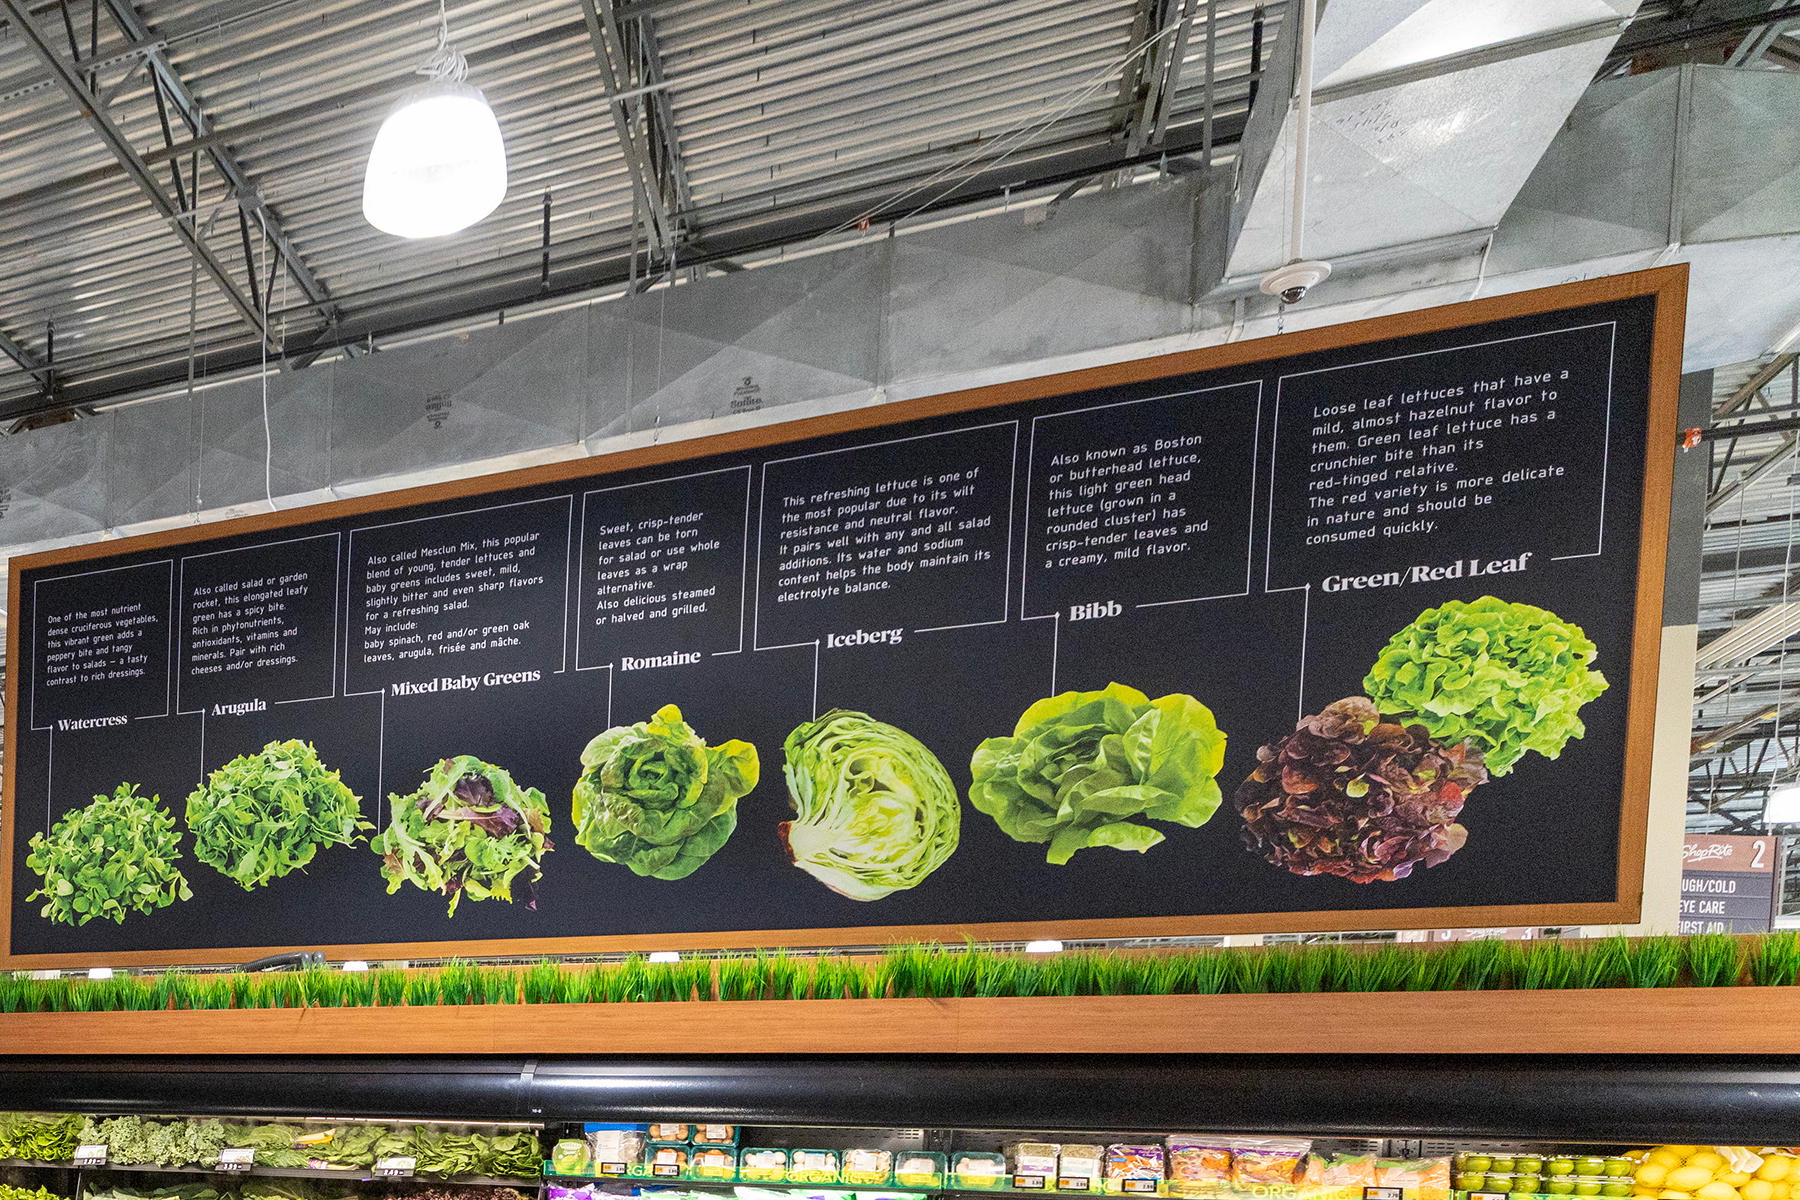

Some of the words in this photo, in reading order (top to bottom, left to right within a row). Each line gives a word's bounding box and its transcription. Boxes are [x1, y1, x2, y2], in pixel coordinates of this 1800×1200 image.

[1050, 453, 1080, 467] Also
[1085, 446, 1126, 462] known
[1132, 443, 1148, 455] as
[1154, 435, 1203, 451] Boston
[1049, 473, 1064, 484] or
[1069, 459, 1143, 481] butterhead
[1148, 453, 1201, 469] lettuce,
[1048, 488, 1073, 501] this
[1078, 482, 1109, 498] light
[1114, 477, 1153, 494] green
[1158, 469, 1191, 485] head
[1047, 503, 1094, 518] lettuce
[1099, 496, 1144, 513] (grown
[1150, 492, 1162, 504] in
[1168, 491, 1177, 501] a
[1046, 517, 1099, 535] rounded
[1104, 508, 1157, 527] cluster)
[1162, 507, 1187, 519] has
[1045, 532, 1128, 552] crisp-tender
[1133, 526, 1178, 541] leaves
[1184, 519, 1209, 534] and
[1044, 559, 1053, 569] a
[1058, 553, 1108, 567] creamy,
[1113, 545, 1140, 560] mild
[1146, 542, 1191, 556] flavor.
[1321, 559, 1463, 593] Green/Red
[1468, 551, 1533, 577] Leaf
[47, 614, 62, 624] One
[63, 612, 73, 622] of
[75, 611, 88, 620] the
[90, 607, 109, 618] most
[110, 602, 142, 615] nutrient
[1069, 600, 1123, 622] Bibb
[47, 627, 69, 637] dense
[71, 621, 113, 634] cruciferous
[115, 614, 159, 628] vegetables,
[47, 640, 62, 649] this
[64, 635, 90, 647] vibrant
[92, 633, 114, 645] green
[116, 630, 135, 640] adds
[137, 629, 143, 637] a
[826, 627, 904, 649] Iceberg
[46, 651, 76, 663] peppery
[78, 648, 93, 658] bite
[95, 645, 110, 656] and
[111, 644, 133, 654] tangy
[46, 664, 69, 674] flavor
[71, 662, 81, 671] to
[82, 659, 107, 670] salads
[119, 657, 125, 665] a
[127, 653, 149, 664] tasty
[621, 650, 702, 672] Romaine
[46, 675, 77, 687] contrast
[80, 674, 89, 683] to
[90, 671, 106, 681] rich
[107, 668, 145, 680] dressings.
[391, 677, 439, 697] Mixed
[441, 674, 481, 692] Baby
[483, 669, 541, 687] Greens
[211, 697, 267, 716] Arugula
[57, 714, 128, 732] Watercress
[1683, 844, 1733, 862] ShopRite
[1751, 840, 1766, 868] 2
[1681, 879, 1736, 894] UGH/COLD
[1699, 901, 1726, 914] CARE
